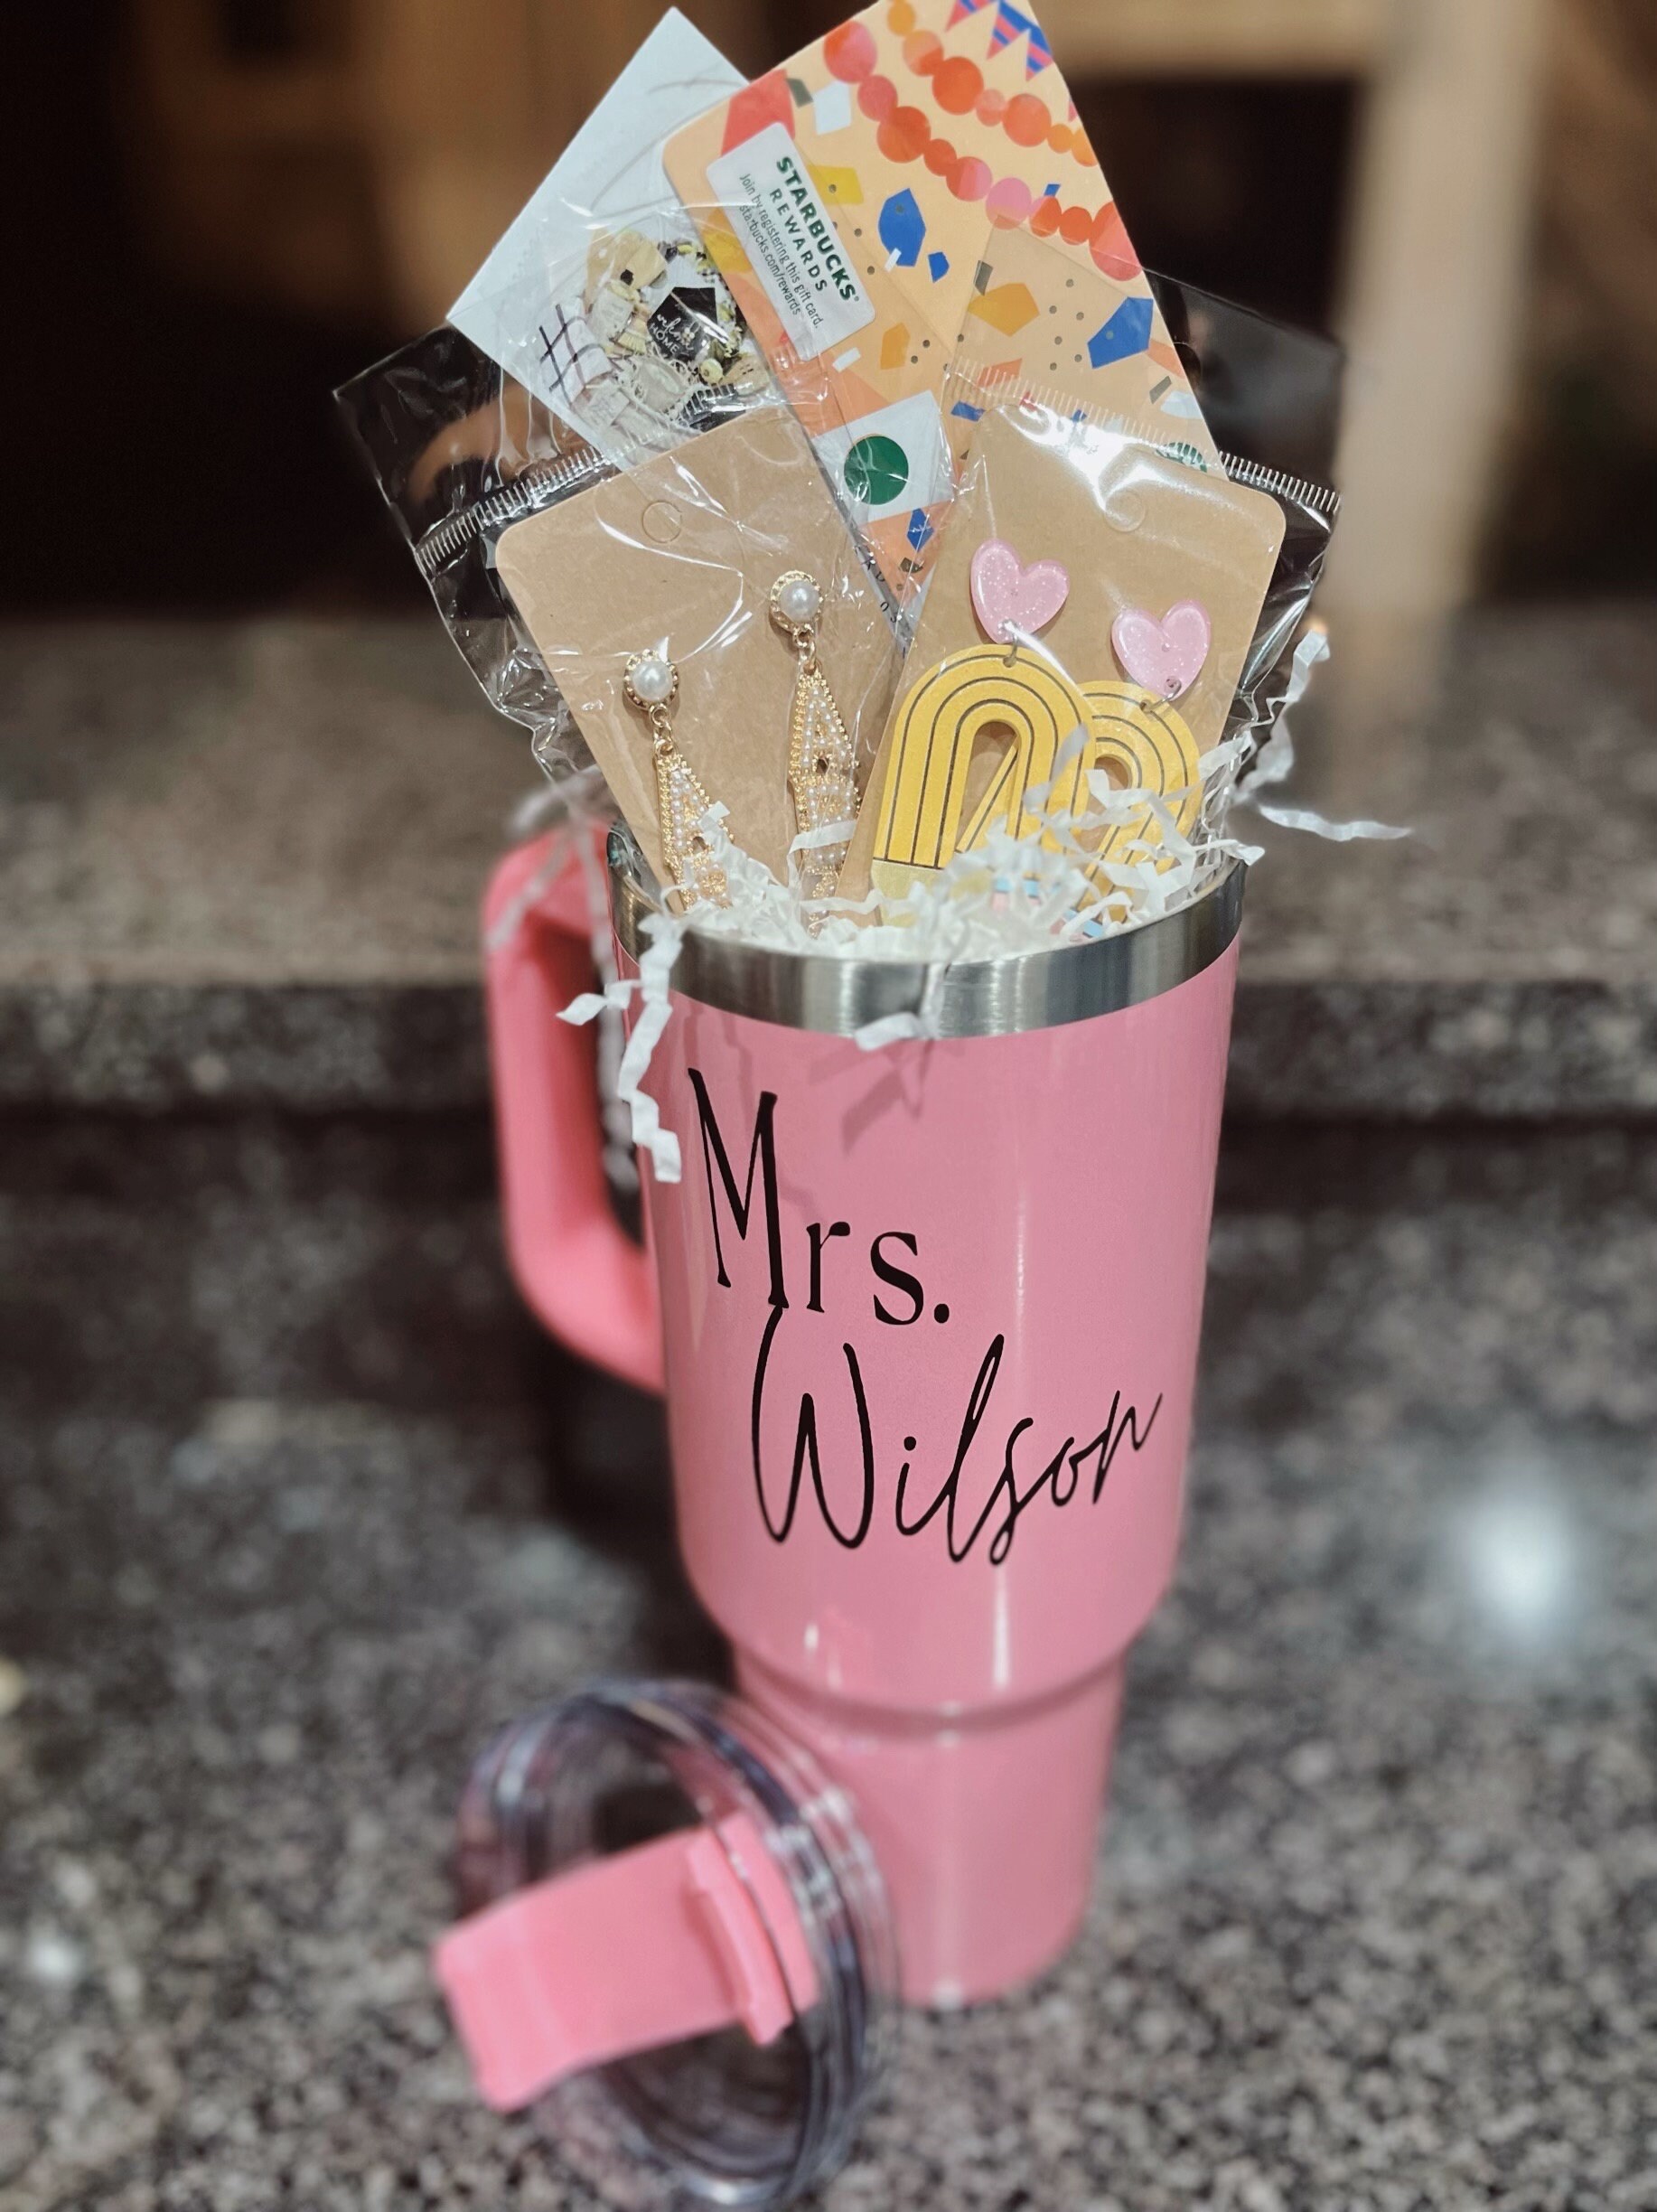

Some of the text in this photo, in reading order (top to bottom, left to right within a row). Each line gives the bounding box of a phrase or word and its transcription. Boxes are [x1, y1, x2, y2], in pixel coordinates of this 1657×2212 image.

[740, 173, 823, 328] Join by registering this gift card.
[770, 188, 827, 292] REWARDS
[650, 323, 679, 354] HOME
[688, 1067, 950, 1326] Mrs.
[752, 1304, 1163, 1565] Wilson
